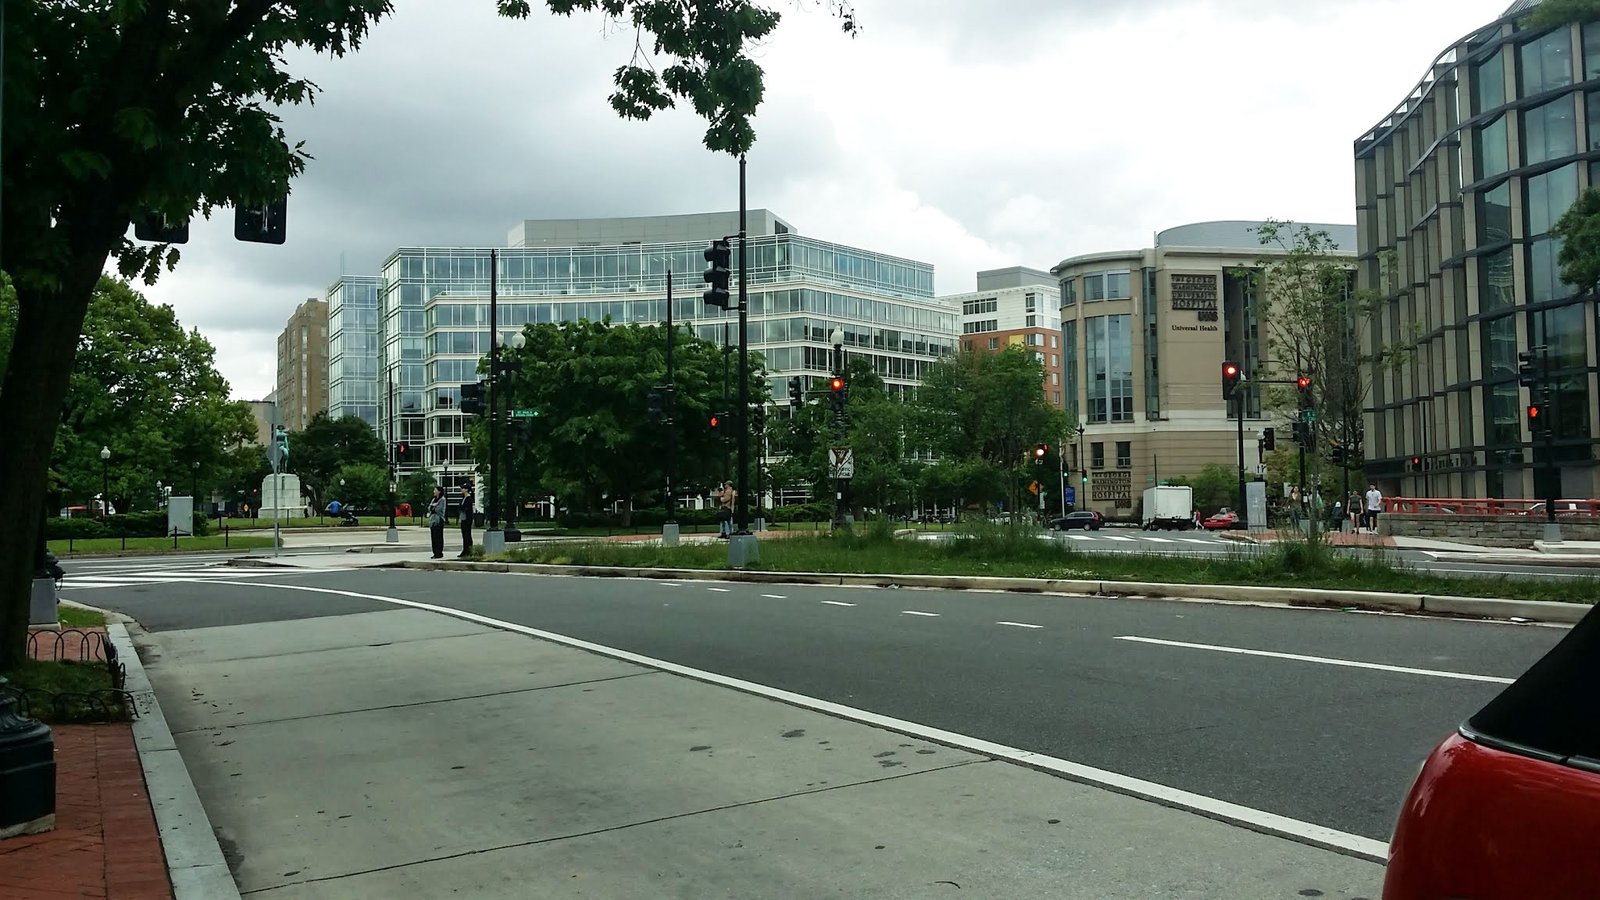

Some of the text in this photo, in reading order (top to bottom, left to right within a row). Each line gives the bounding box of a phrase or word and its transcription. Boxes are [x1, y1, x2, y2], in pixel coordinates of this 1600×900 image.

[1186, 275, 1217, 283] GEORGE
[1172, 291, 1217, 299] UNIVERSITY
[1172, 299, 1217, 308] HOSPITAL
[1092, 491, 1131, 499] HOSPITAL
